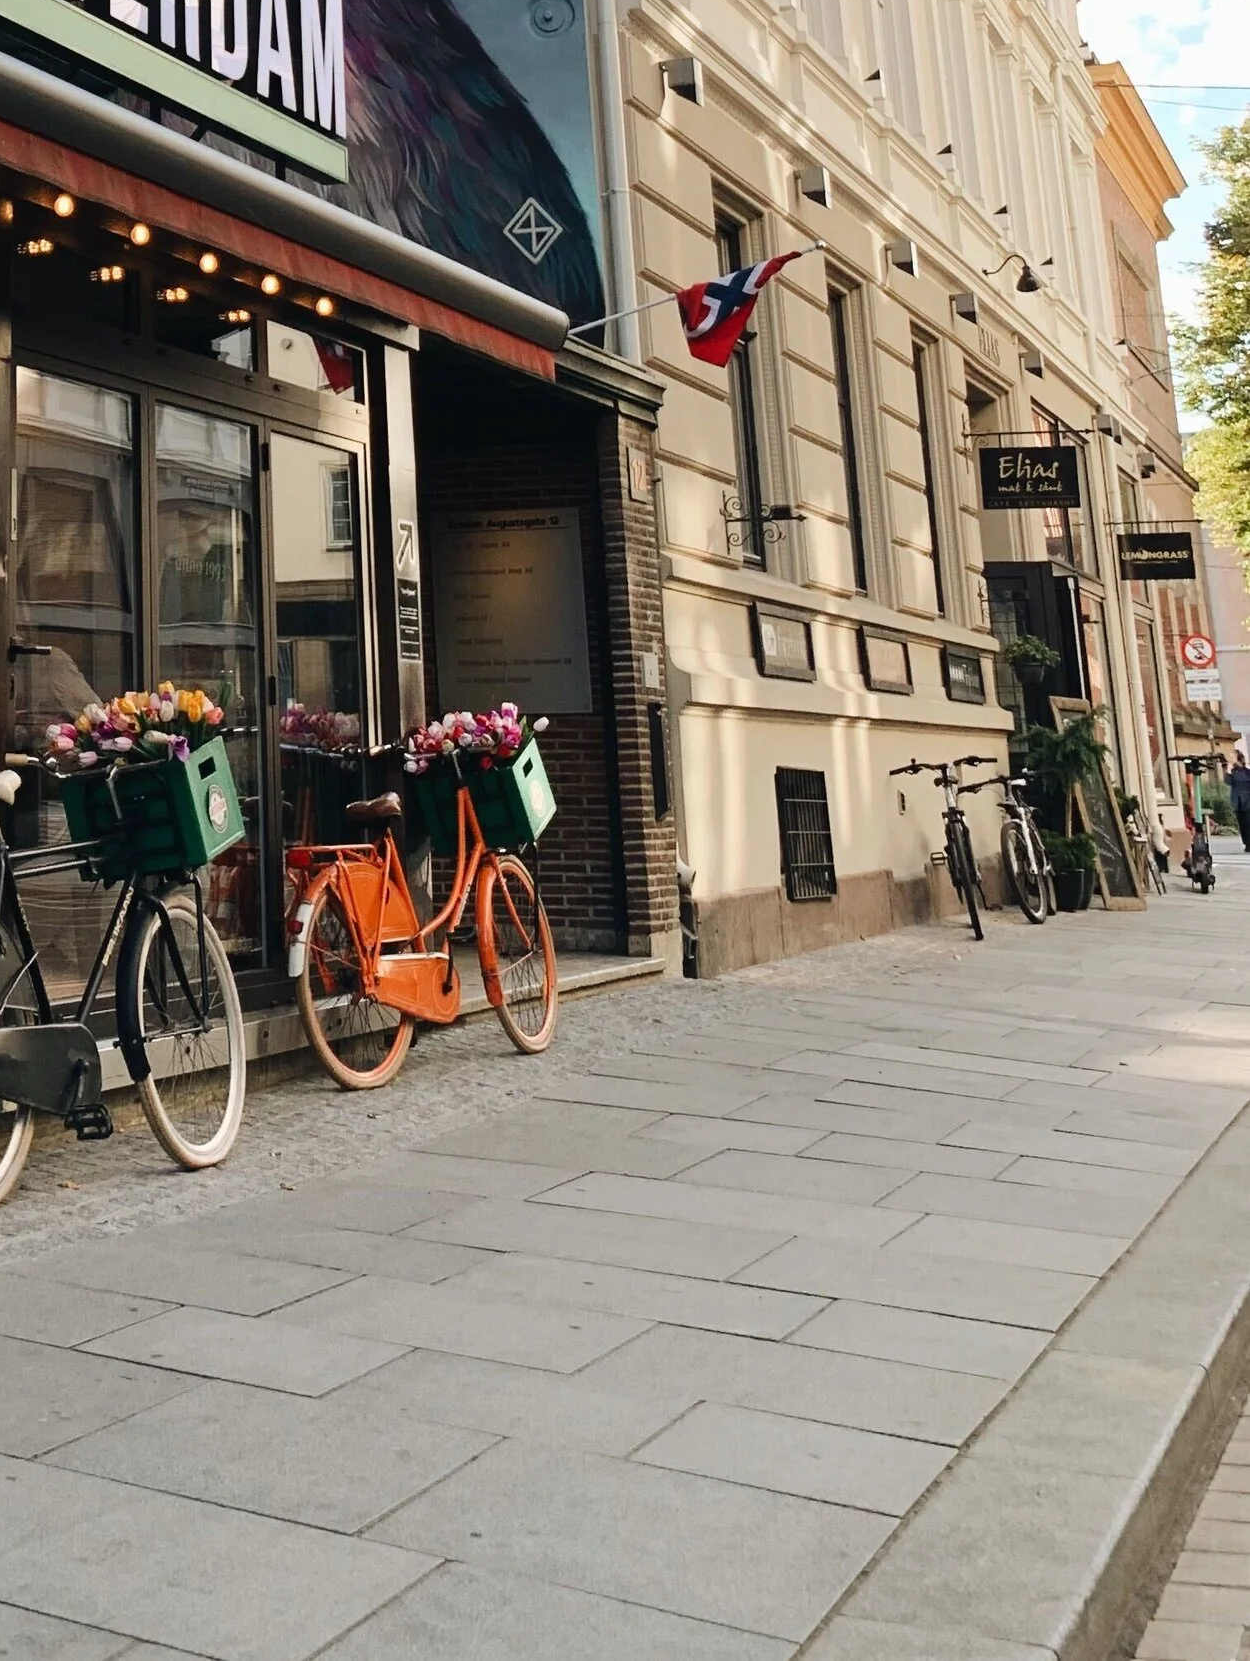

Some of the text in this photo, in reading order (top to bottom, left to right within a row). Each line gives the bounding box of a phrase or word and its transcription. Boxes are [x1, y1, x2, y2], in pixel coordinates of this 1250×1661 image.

[998, 452, 1059, 479] Elias
[998, 481, 1021, 493] mat
[1121, 549, 1189, 560] LEMONGRASS
